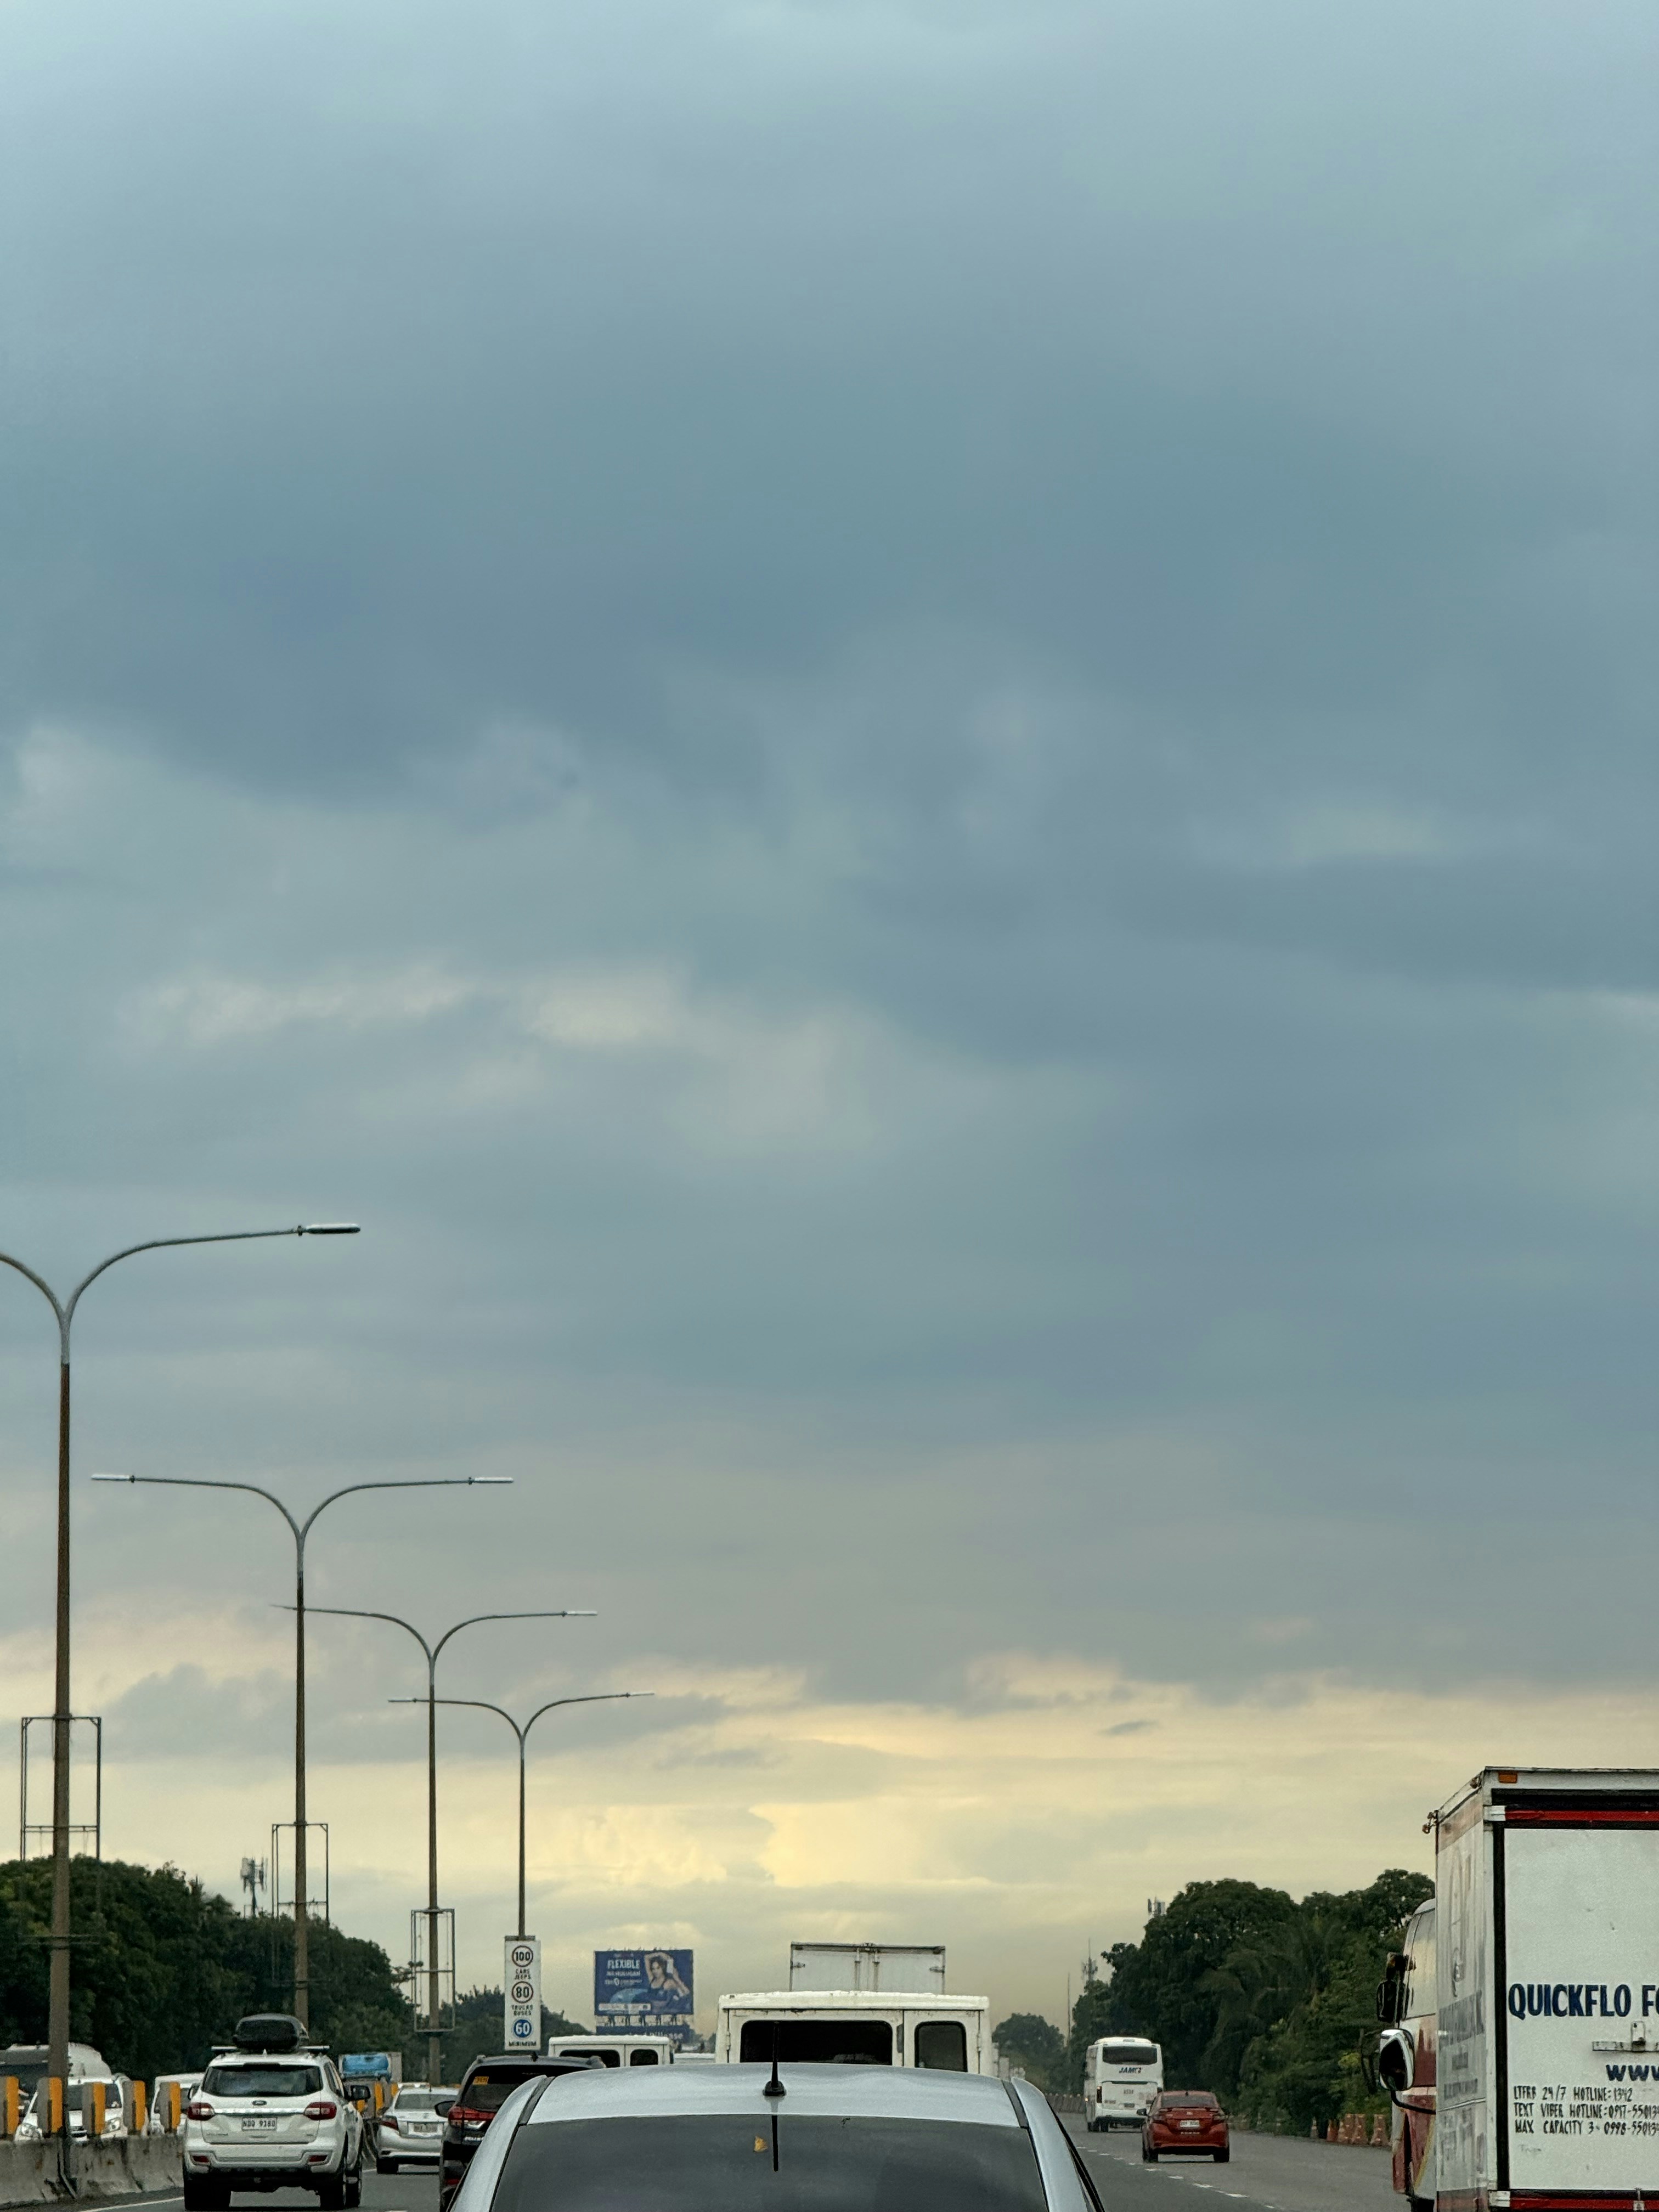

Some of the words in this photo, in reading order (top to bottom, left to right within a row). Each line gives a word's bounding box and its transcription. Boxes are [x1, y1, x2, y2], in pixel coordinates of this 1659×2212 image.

[515, 1951, 531, 1961] 100
[607, 1959, 640, 1970] FLEXIBLE
[516, 1987, 529, 1998] 80
[1508, 1983, 1632, 2021] QUICKFLO
[1642, 1984, 1659, 2017] F
[516, 2022, 530, 2035] 60
[1514, 2085, 1536, 2100] LTFRB
[1542, 2084, 1566, 2101] 24/7
[1514, 2102, 1534, 2117] TEXT
[1541, 2103, 1564, 2118] VIBER
[1515, 2119, 1534, 2134] MAX
[1543, 2120, 1583, 2135] CAPACITY
